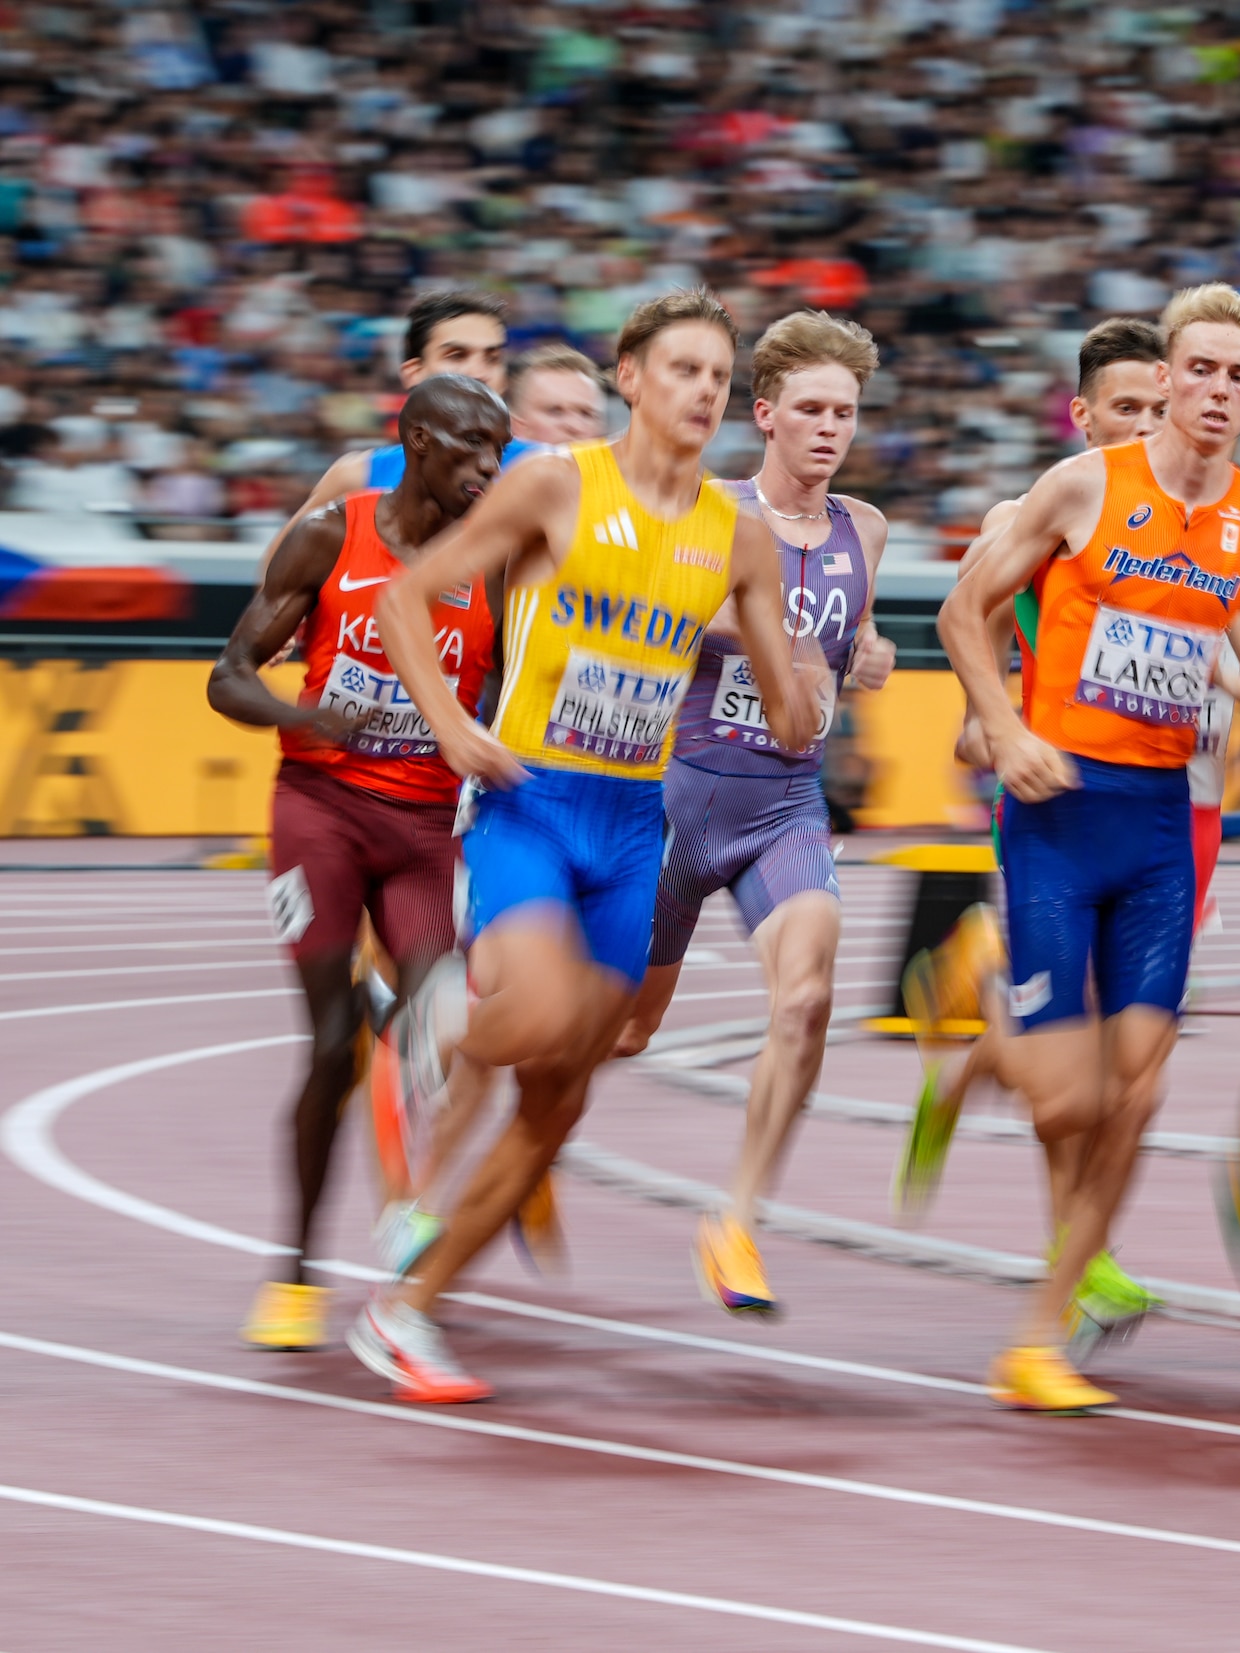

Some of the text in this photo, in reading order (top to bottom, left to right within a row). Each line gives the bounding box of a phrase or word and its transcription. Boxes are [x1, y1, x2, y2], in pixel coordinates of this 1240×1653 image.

[779, 580, 848, 641] SA
[336, 611, 464, 670] KEA
[609, 668, 681, 708] TDK
[342, 699, 438, 739] CHERUIYO
